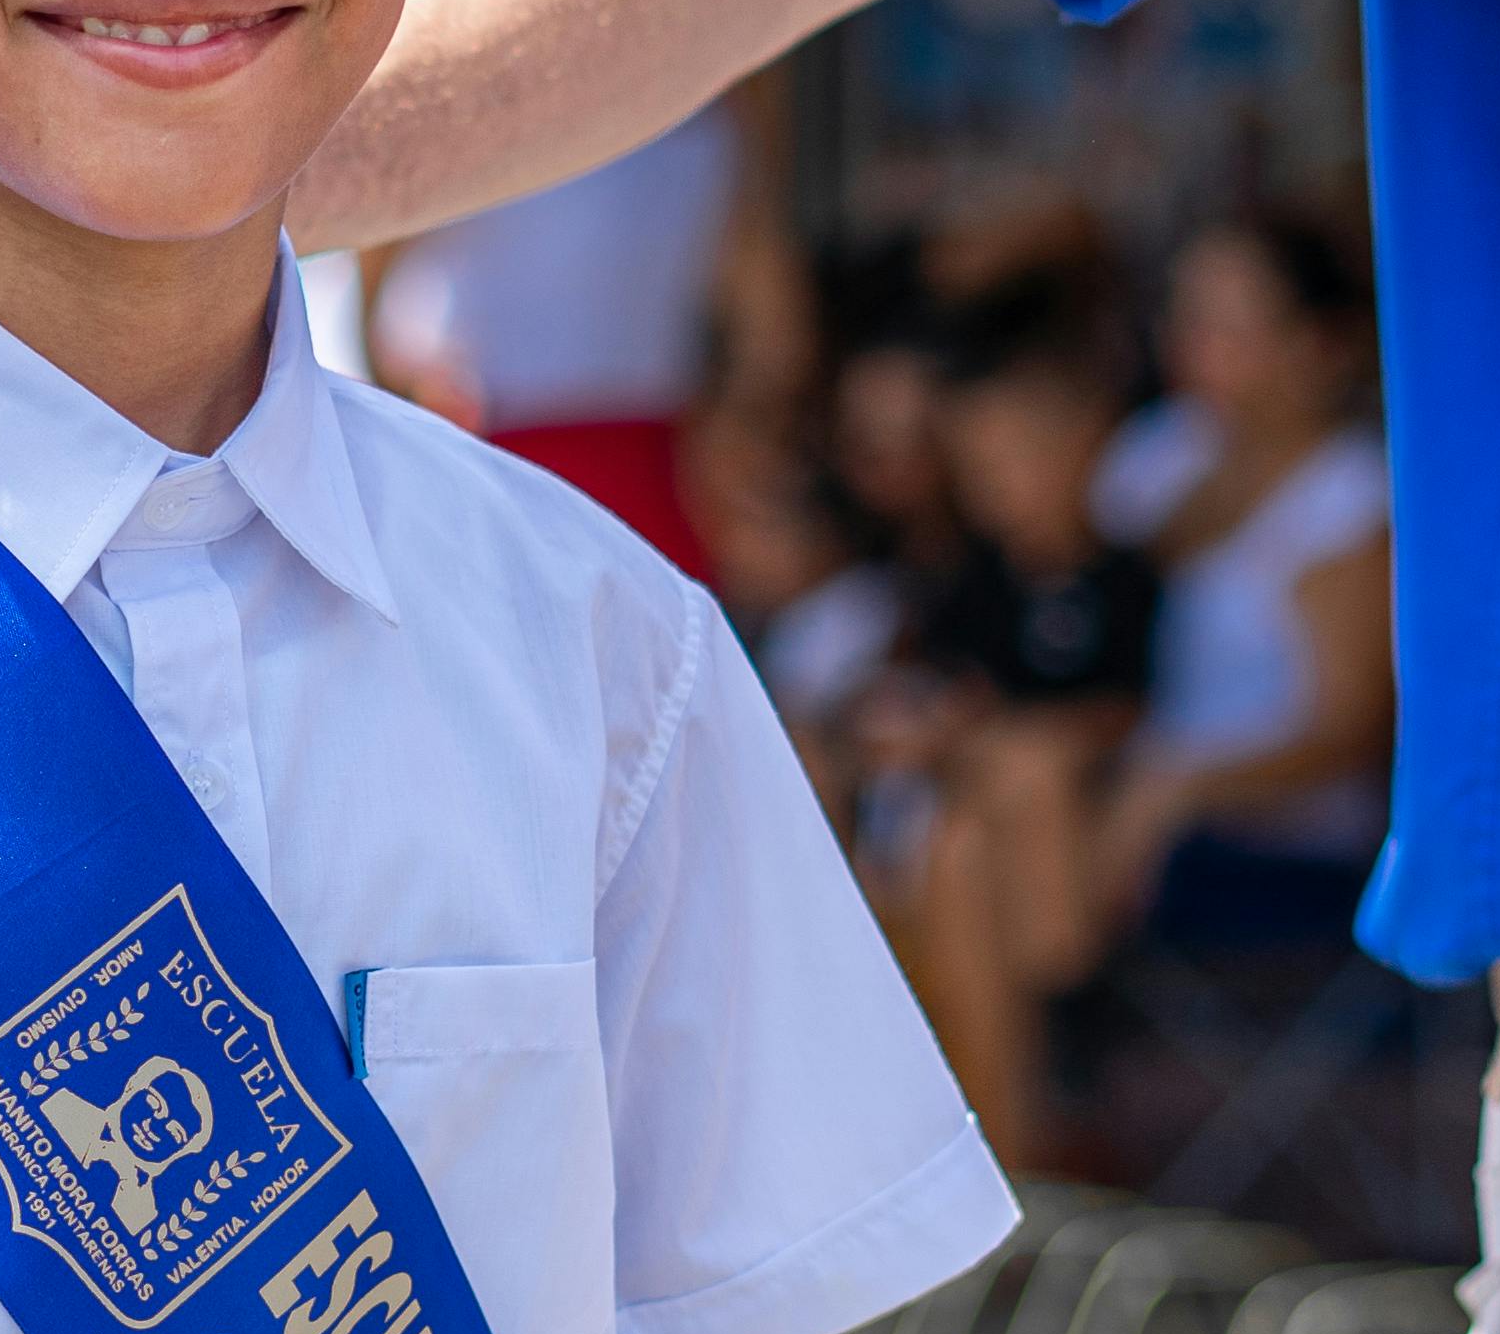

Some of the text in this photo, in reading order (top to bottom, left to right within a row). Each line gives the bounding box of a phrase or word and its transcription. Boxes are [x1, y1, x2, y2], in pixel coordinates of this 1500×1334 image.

[16, 987, 88, 1048] CIVISMO
[158, 950, 301, 1152] ESCUELA
[23, 1191, 58, 1230] 1991
[250, 1157, 310, 1213] HONOR
[48, 1192, 125, 1294] PUNTARENAS
[49, 1159, 96, 1215] MORA
[95, 1217, 155, 1301] PORRAS
